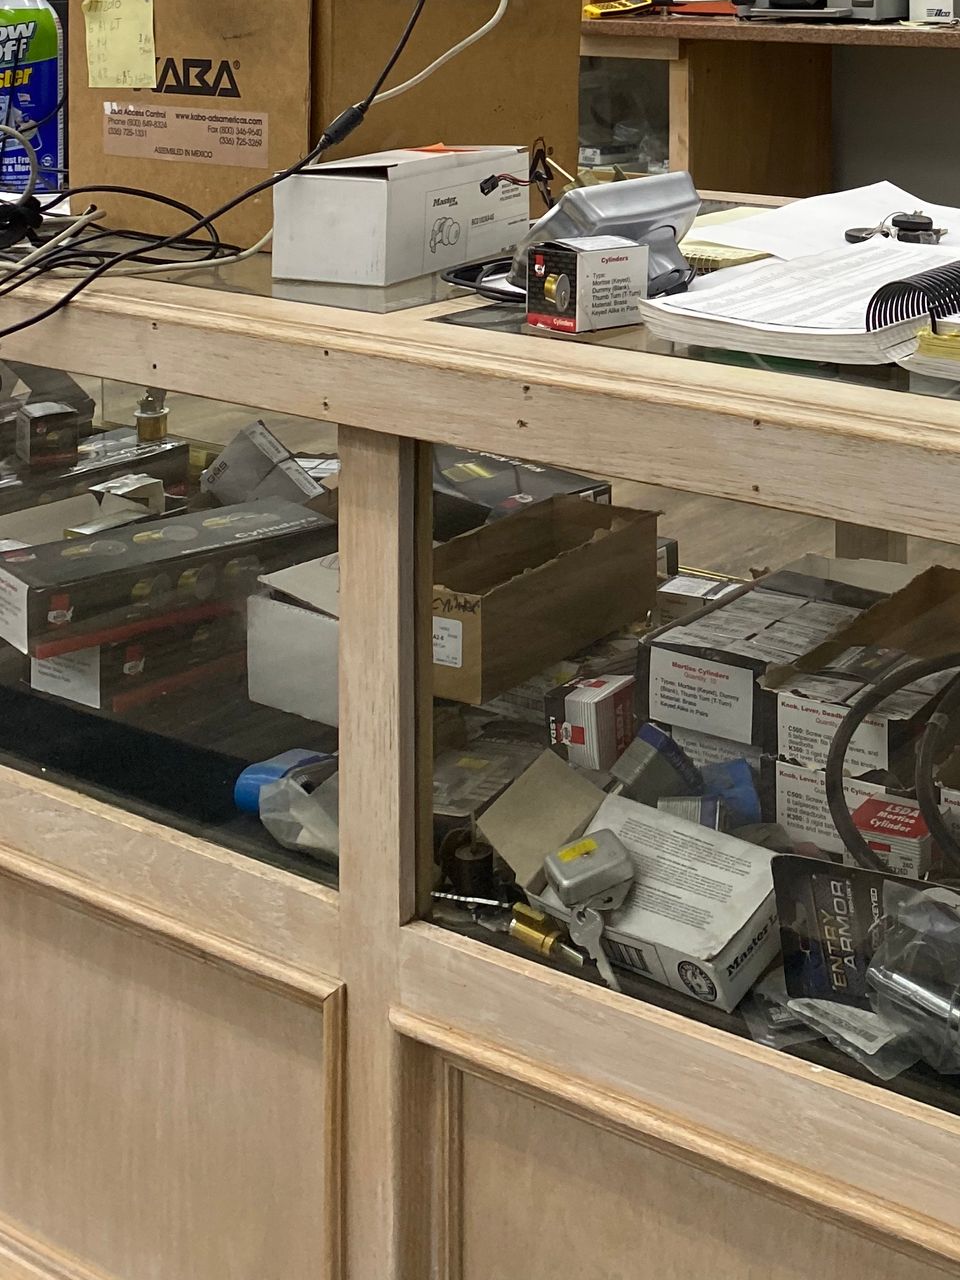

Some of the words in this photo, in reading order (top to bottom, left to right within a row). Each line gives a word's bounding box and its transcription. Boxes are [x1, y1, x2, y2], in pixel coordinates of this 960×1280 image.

[150, 57, 241, 98] ABA
[124, 108, 144, 117] Access
[145, 109, 166, 118] Control
[108, 117, 126, 125] Phone
[127, 118, 142, 128] (800)
[207, 125, 218, 134] Fax
[219, 126, 235, 135] (800)
[154, 146, 184, 156] ASSEMBLED
[191, 148, 212, 158] MEXICO
[433, 197, 456, 207] Master
[601, 255, 628, 264] Cylinders
[592, 286, 612, 295] Dummy
[592, 293, 609, 301] Thumb
[553, 317, 574, 327] Cylinders
[234, 517, 318, 538] Cylinders
[671, 661, 696, 672] Mortise
[698, 668, 730, 680] Cylinders
[781, 701, 800, 710] Knob,
[801, 705, 821, 716] Lever,
[549, 716, 557, 745] LSDA
[779, 770, 798, 780] Knob,
[799, 776, 819, 786] Lever,
[877, 811, 916, 824] Mortise
[885, 804, 920, 818] LSDA
[870, 818, 912, 833] Cylinder
[831, 880, 857, 971] ARMOR
[725, 923, 769, 977] Master
[821, 909, 848, 988] ENTRY
